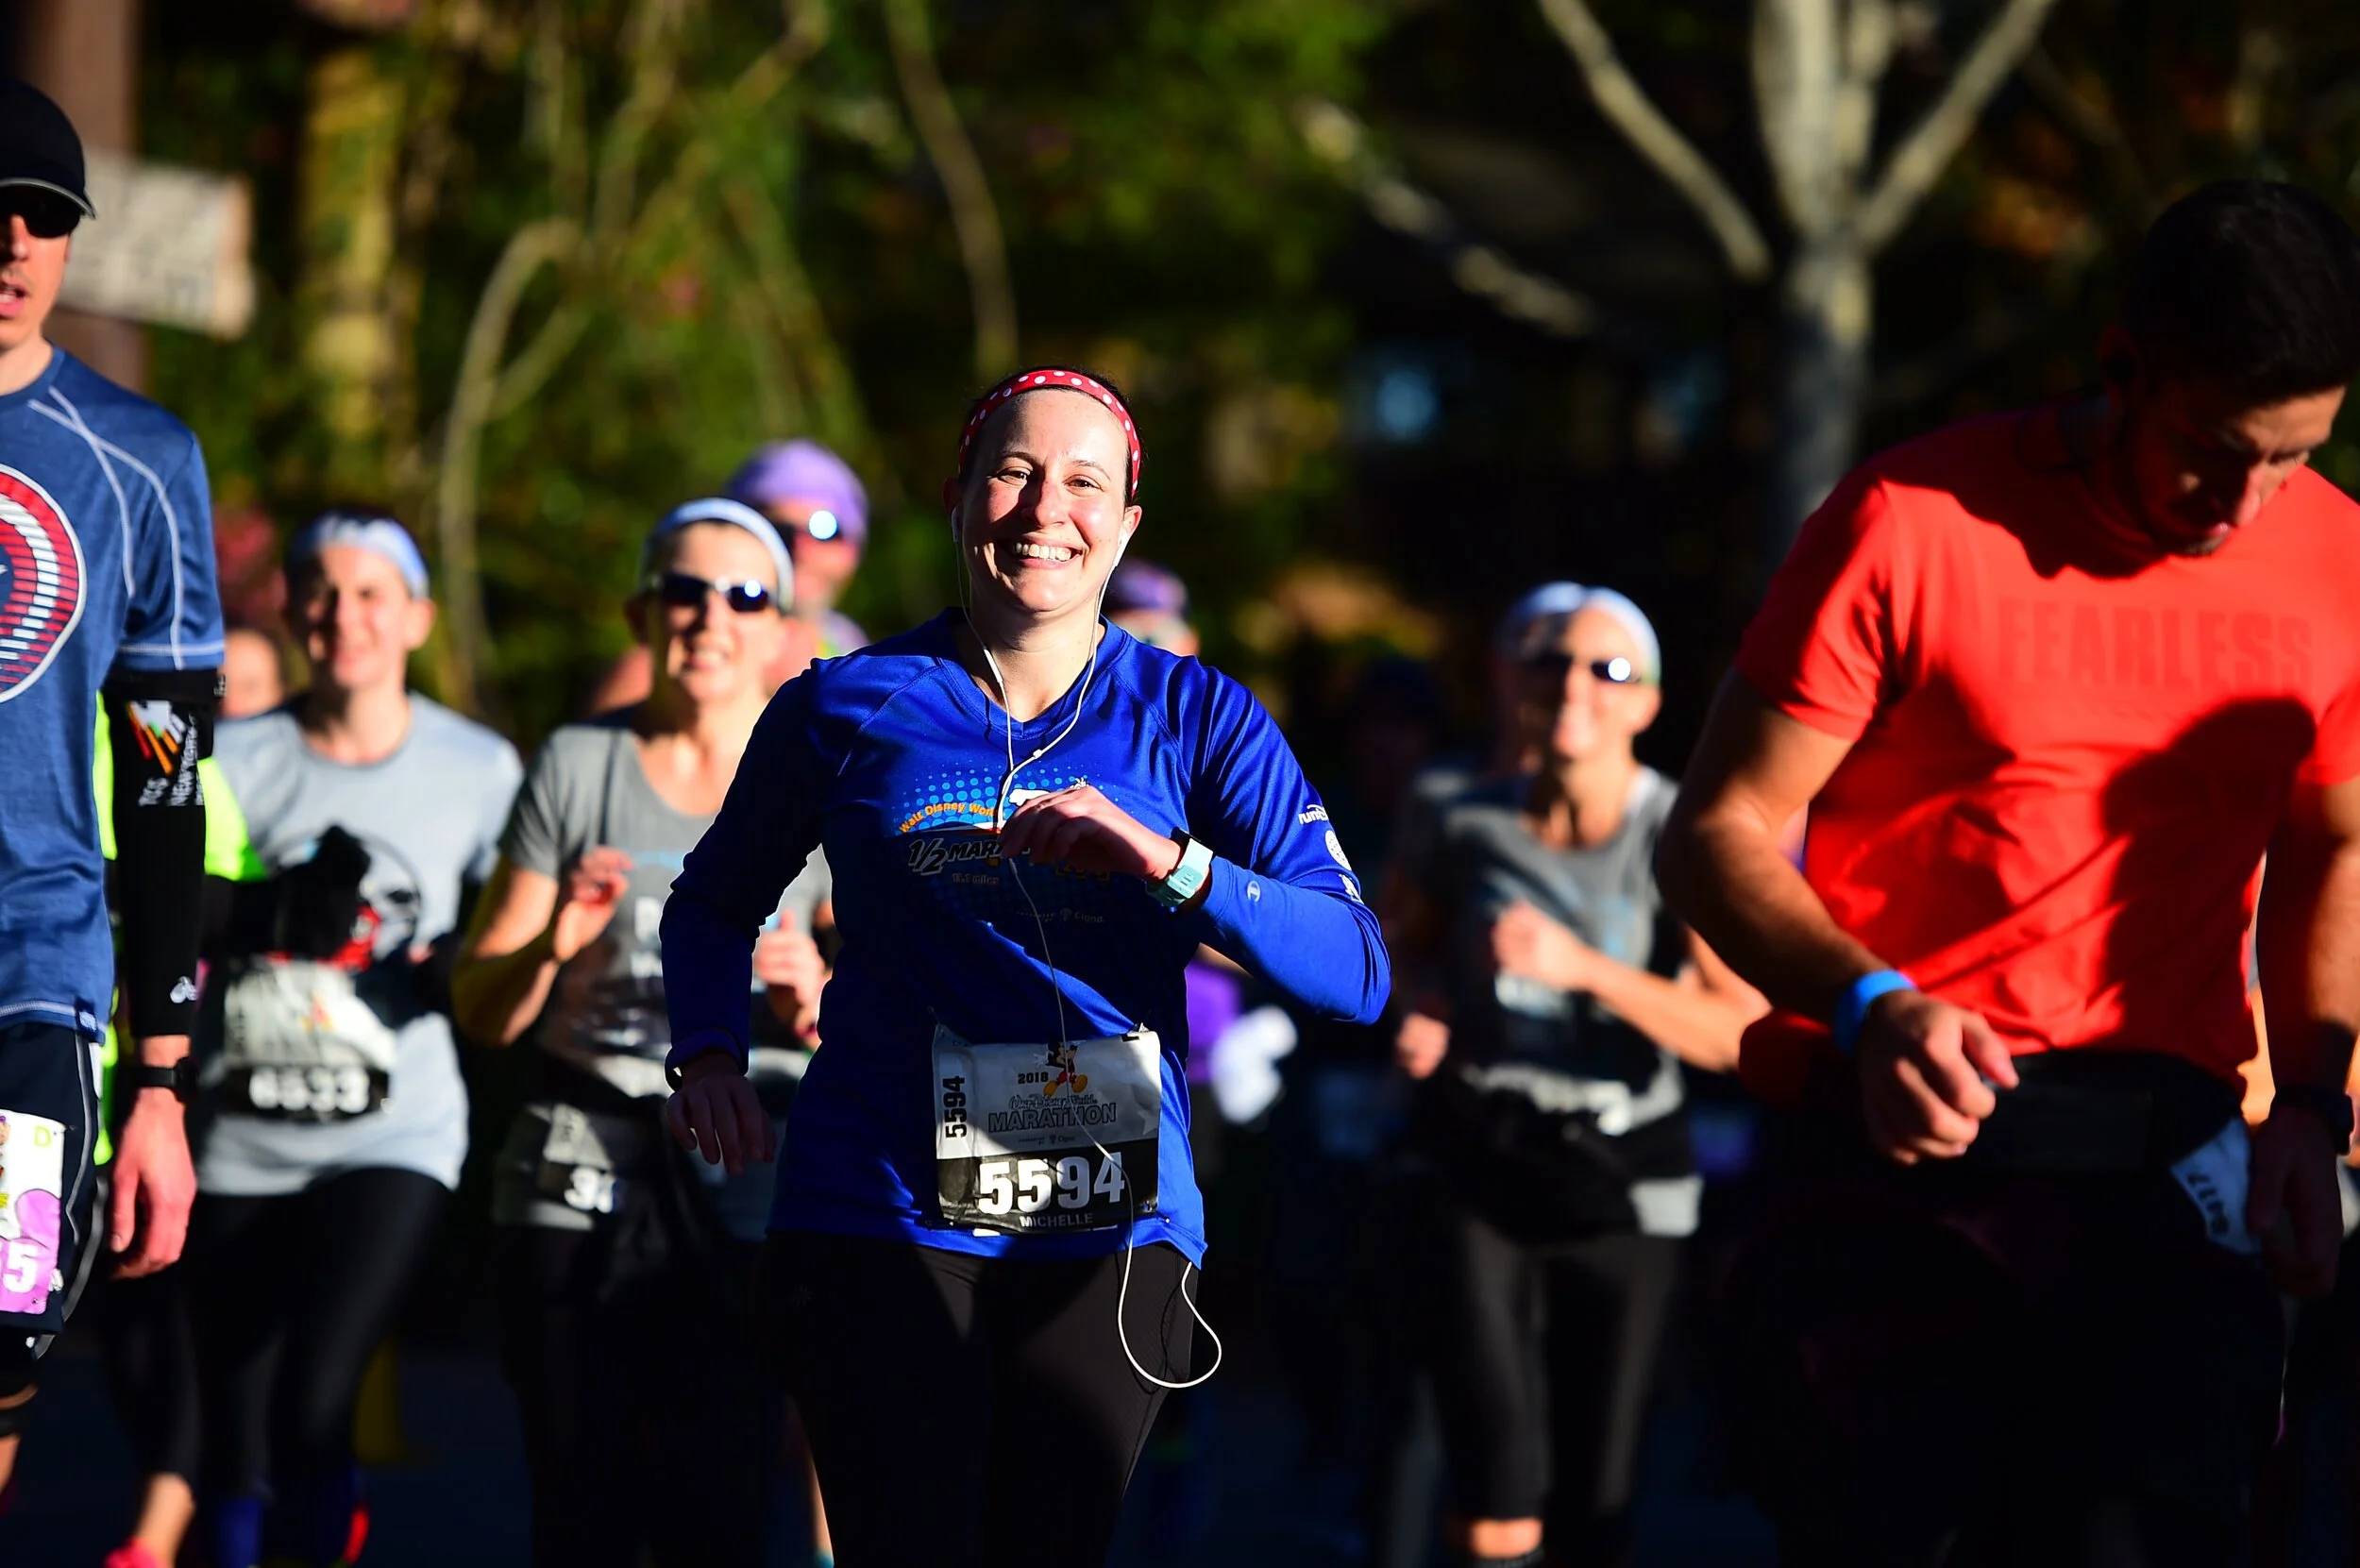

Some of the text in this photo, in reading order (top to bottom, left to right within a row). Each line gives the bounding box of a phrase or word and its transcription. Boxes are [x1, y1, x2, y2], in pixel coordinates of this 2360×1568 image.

[1997, 597, 2313, 697] FEARLESS
[899, 812, 924, 833] Walt
[924, 801, 967, 816] Disney
[1018, 1071, 1049, 1085] 2018
[942, 1074, 968, 1139] 5594
[987, 1102, 1117, 1134] MARATHON
[977, 1151, 1125, 1216] 5594
[1020, 1212, 1094, 1227] MICHELLE
